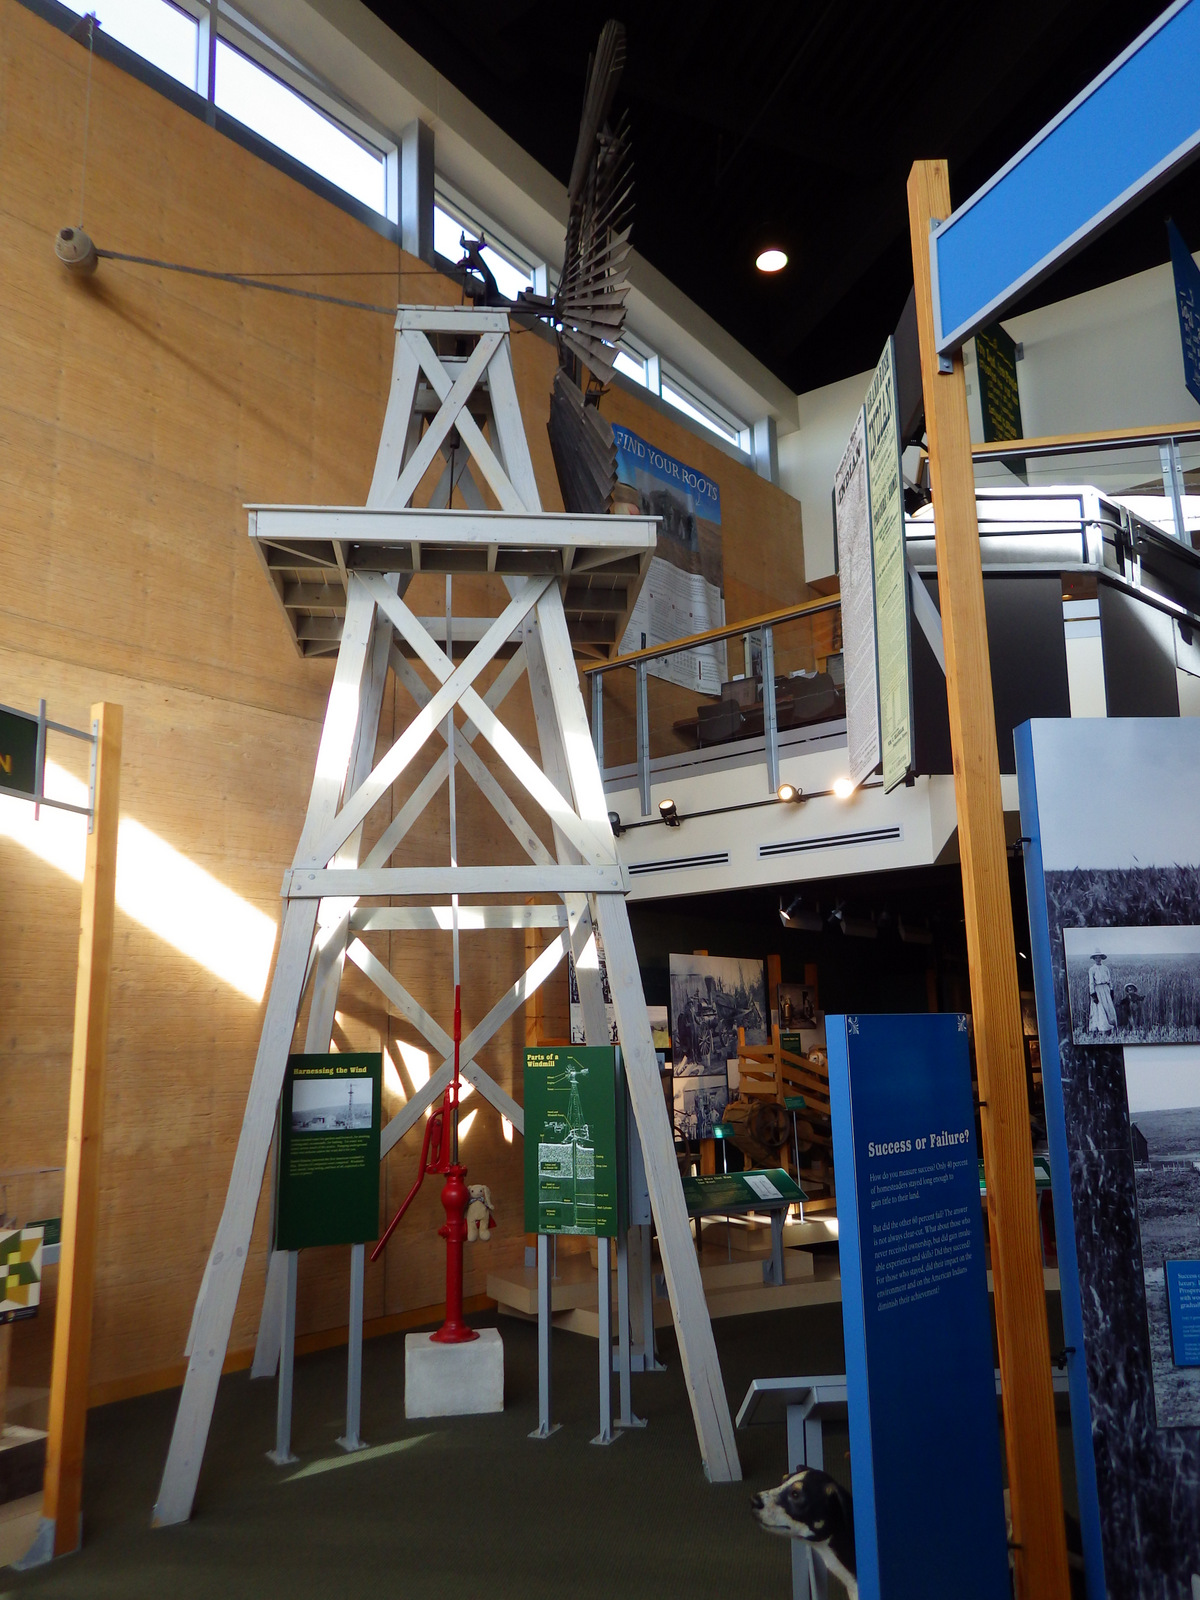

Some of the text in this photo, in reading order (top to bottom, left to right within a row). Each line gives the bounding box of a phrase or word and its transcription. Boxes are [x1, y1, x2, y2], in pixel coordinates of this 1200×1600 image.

[869, 377, 892, 460] INDIAN
[617, 432, 718, 501] FIND YOUR ROOTS
[293, 1067, 334, 1075] Harnessing
[868, 1129, 970, 1157] Success or Failure?
[869, 1172, 881, 1181] How
[889, 1171, 898, 1180] you
[917, 1164, 935, 1172] success?
[935, 1162, 946, 1170] Only
[952, 1159, 968, 1169] percent
[870, 1186, 876, 1194] of
[908, 1178, 922, 1188] stayed
[922, 1176, 932, 1186] long
[932, 1174, 948, 1184] enough
[870, 1198, 881, 1209] gain
[881, 1196, 891, 1205] title
[897, 1192, 908, 1201] their
[872, 1224, 881, 1233] But
[881, 1221, 890, 1230] did
[890, 1220, 898, 1228] the
[898, 1217, 911, 1226] other
[918, 1212, 934, 1224] percent
[944, 1208, 952, 1216] The
[953, 1206, 968, 1214] answer
[878, 1236, 887, 1244] not
[887, 1232, 902, 1244] always
[924, 1224, 936, 1233] What
[936, 1221, 949, 1230] about
[949, 1218, 960, 1227] those
[961, 1216, 970, 1224] who
[874, 1249, 888, 1259] never
[888, 1243, 907, 1255] received
[932, 1235, 940, 1243] but
[940, 1233, 948, 1242] did
[948, 1231, 957, 1242] gain
[885, 1256, 911, 1271] experience
[911, 1253, 920, 1262] and
[934, 1247, 942, 1256] Did
[943, 1244, 952, 1255] they
[876, 1275, 884, 1285] For
[885, 1272, 898, 1282] those
[898, 1269, 909, 1278] who
[933, 1259, 943, 1269] their
[944, 1255, 958, 1267] impact
[964, 1251, 972, 1260] the
[876, 1282, 906, 1299] environment
[907, 1279, 915, 1289] and
[916, 1278, 922, 1286] on
[930, 1269, 951, 1282] American
[951, 1264, 967, 1276] Indians
[898, 1294, 909, 1304] their
